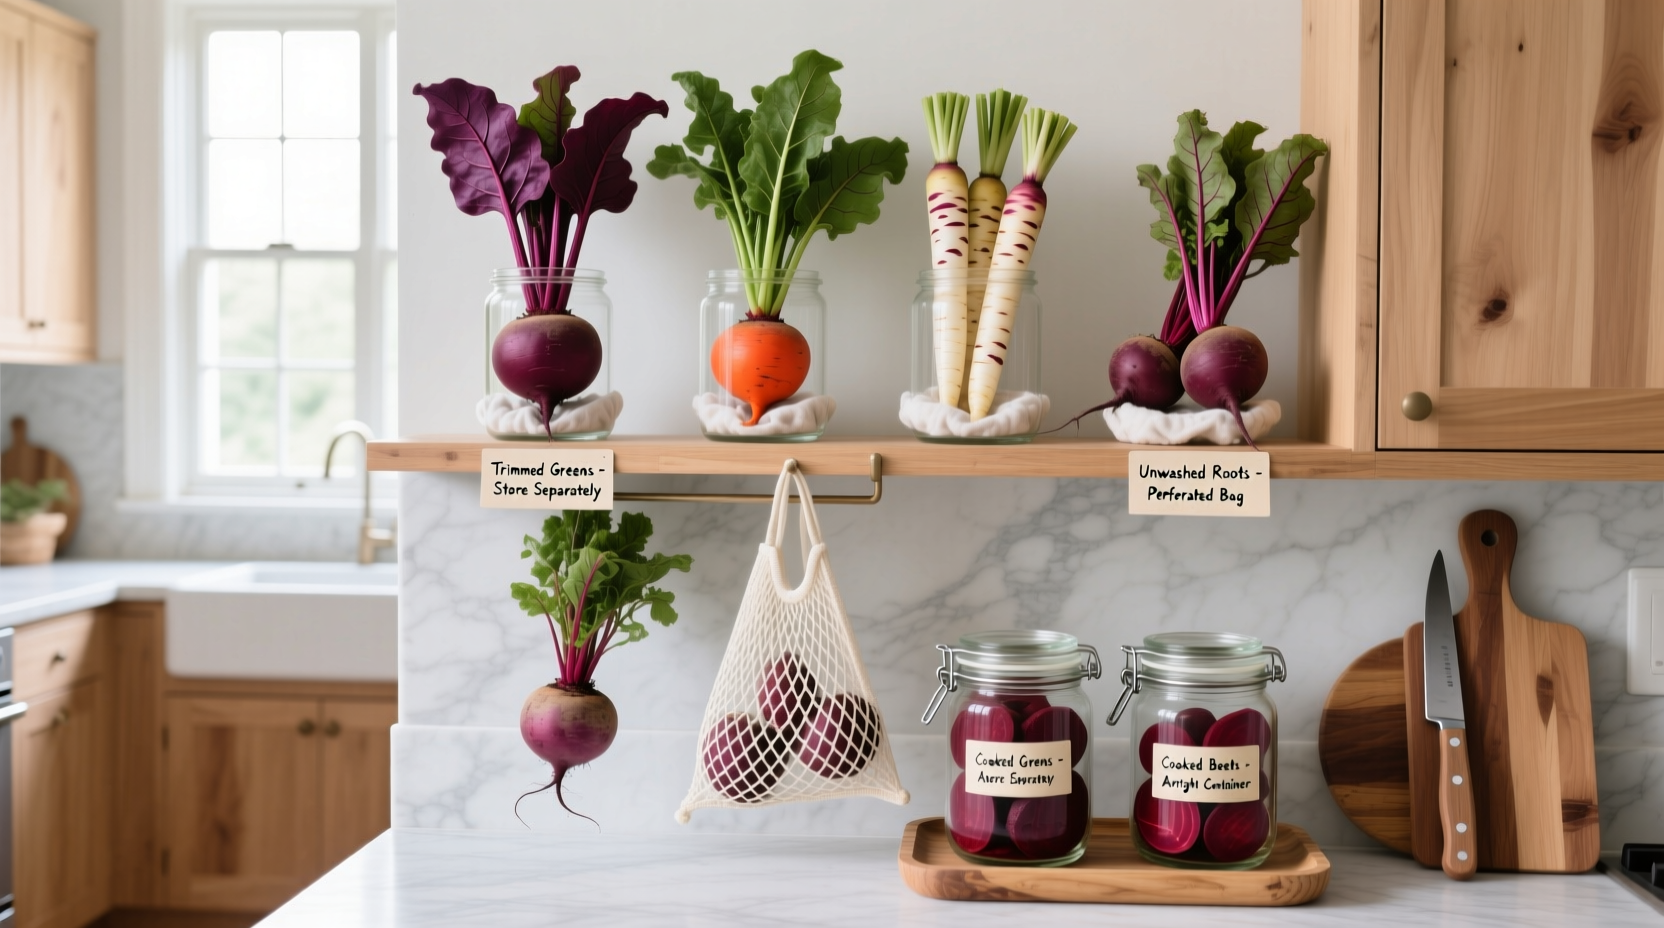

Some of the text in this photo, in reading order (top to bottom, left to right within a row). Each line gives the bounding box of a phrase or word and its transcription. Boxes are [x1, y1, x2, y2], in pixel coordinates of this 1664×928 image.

[491, 461, 545, 476] Trimmed
[550, 462, 594, 477] Greens
[1139, 464, 1206, 479] Unwashed
[1212, 464, 1250, 480] Roots
[493, 481, 602, 502] Store Separately
[1220, 487, 1244, 507] Bag
[975, 752, 1014, 767] Cooked
[1019, 754, 1053, 768] Grens
[1161, 755, 1203, 771] Cooked
[1209, 758, 1240, 771] Beets
